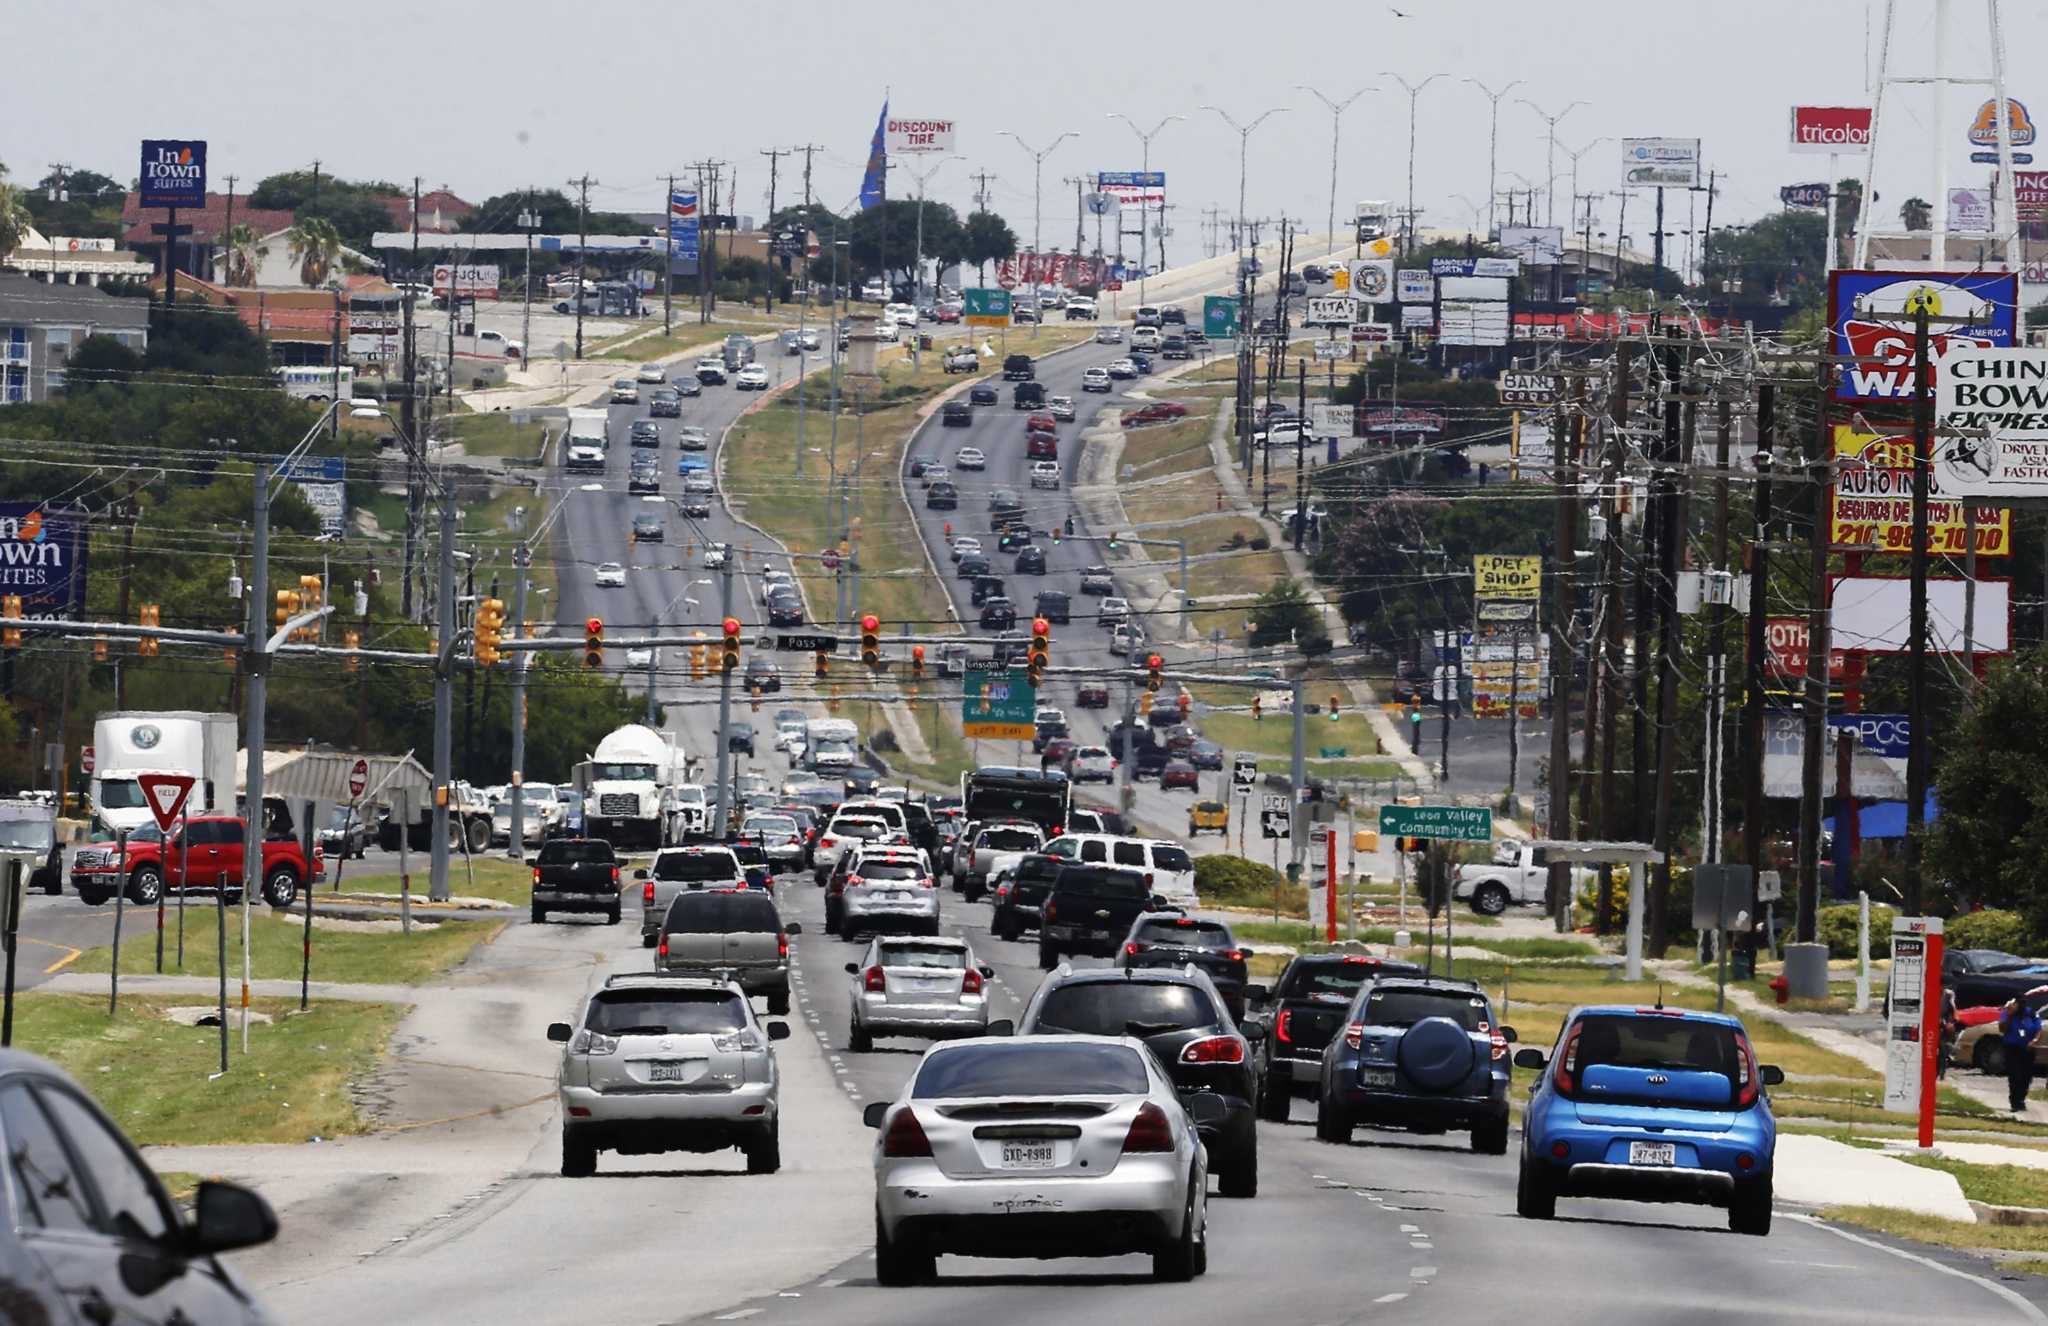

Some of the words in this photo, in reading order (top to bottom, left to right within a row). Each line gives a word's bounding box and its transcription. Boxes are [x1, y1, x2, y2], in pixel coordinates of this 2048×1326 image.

[888, 121, 953, 132] DISCOUNT
[1802, 123, 1872, 144] tricolor
[908, 133, 935, 145] TIRE
[158, 148, 179, 164] In
[146, 162, 202, 178] Town
[153, 178, 193, 189] SUITES
[1969, 329, 2008, 337] AMERICA
[1950, 360, 2048, 379] CHIN
[2002, 444, 2038, 456] DRIVE
[1841, 471, 1890, 494] AUTO
[1837, 498, 1890, 521] SEGUROS
[1893, 501, 1910, 522] DE
[1491, 557, 1524, 571] PET
[1484, 572, 1532, 585] SHOP
[1414, 811, 1441, 821] Leon
[1446, 810, 1484, 823] Valley
[1399, 823, 1465, 838] Community
